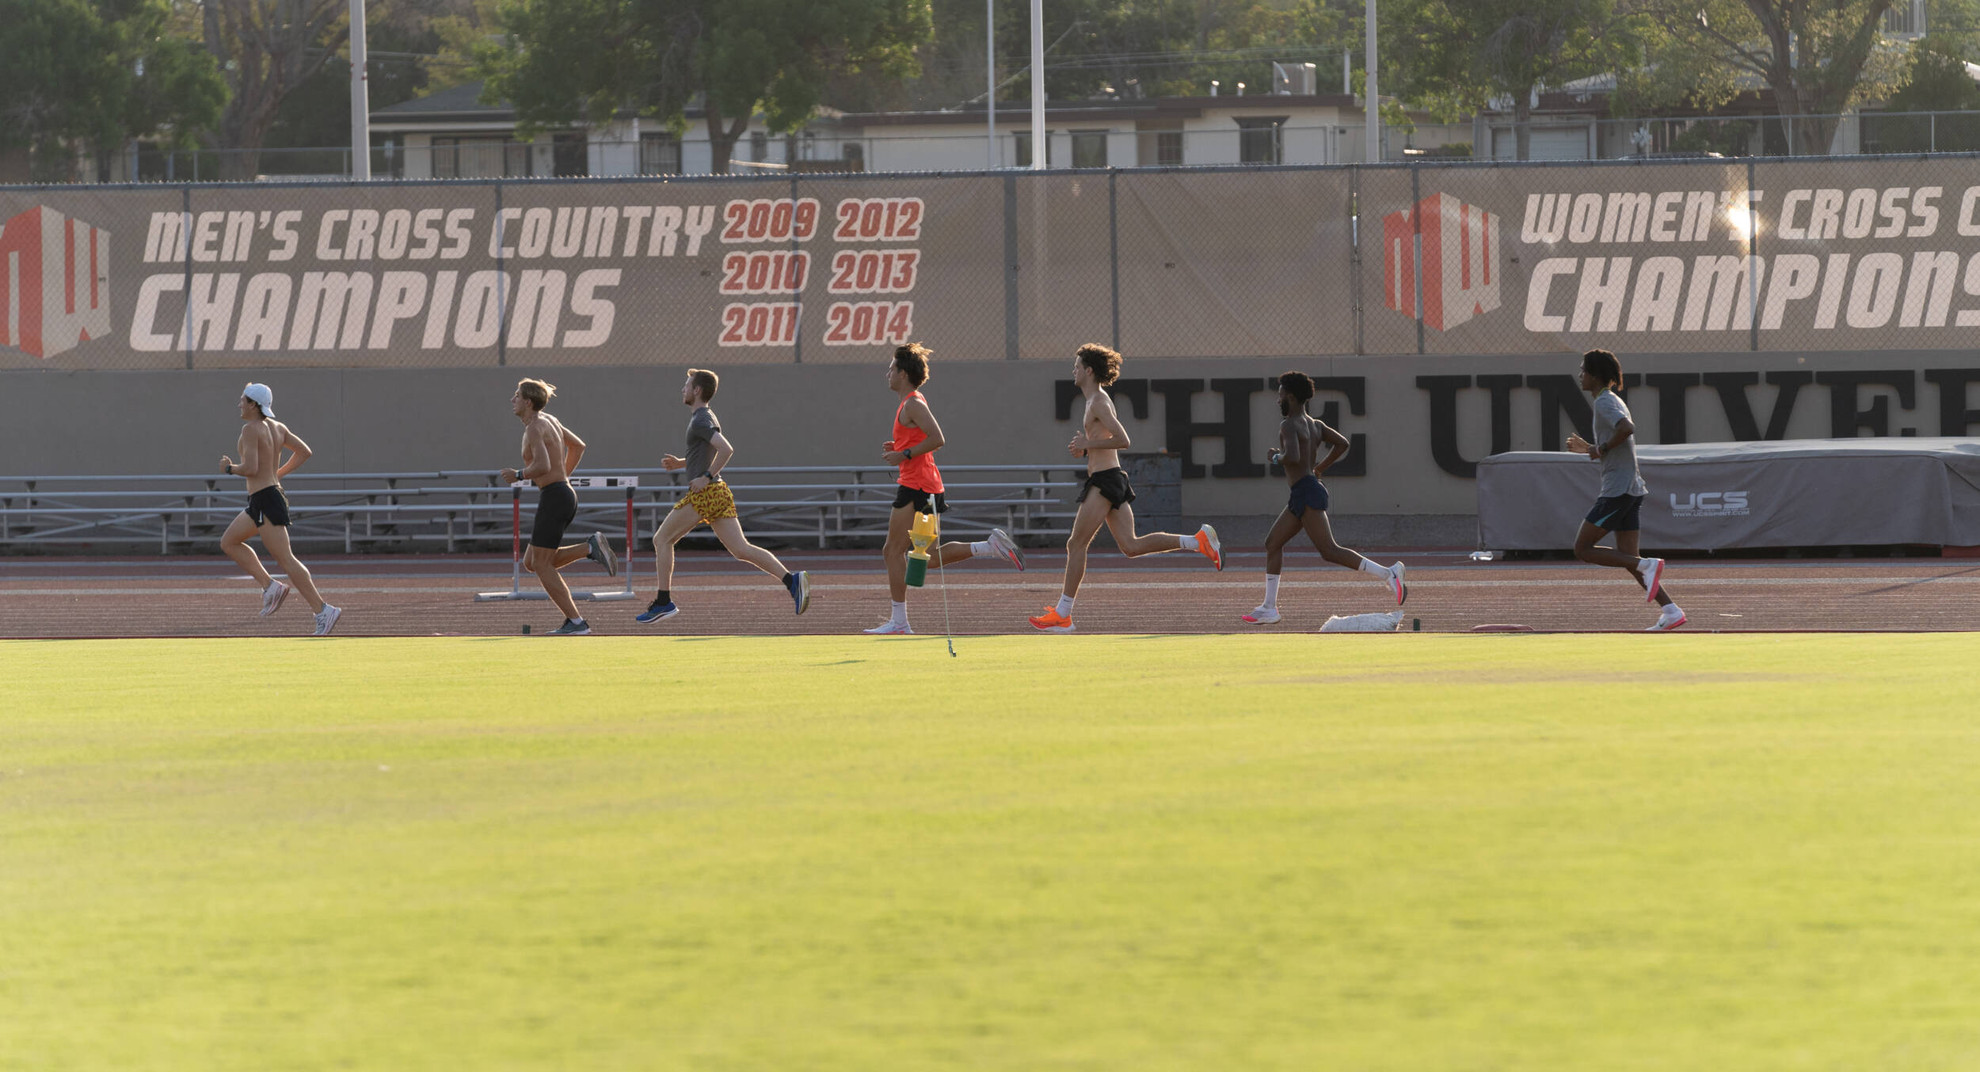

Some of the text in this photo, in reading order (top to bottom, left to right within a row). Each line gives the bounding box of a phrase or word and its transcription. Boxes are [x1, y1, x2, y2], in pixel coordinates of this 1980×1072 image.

[142, 205, 716, 263] MEN'S CROSS COUNTRY
[720, 197, 925, 244] 2009 2012
[1520, 189, 1764, 244] WOMEN'S
[1777, 186, 1944, 240] CROSS
[719, 249, 921, 295] 2010 2013
[129, 268, 622, 352] CHAMPIONS
[718, 301, 914, 347] 2011 2014
[568, 478, 590, 486] CS
[1670, 491, 1748, 509] UCS
